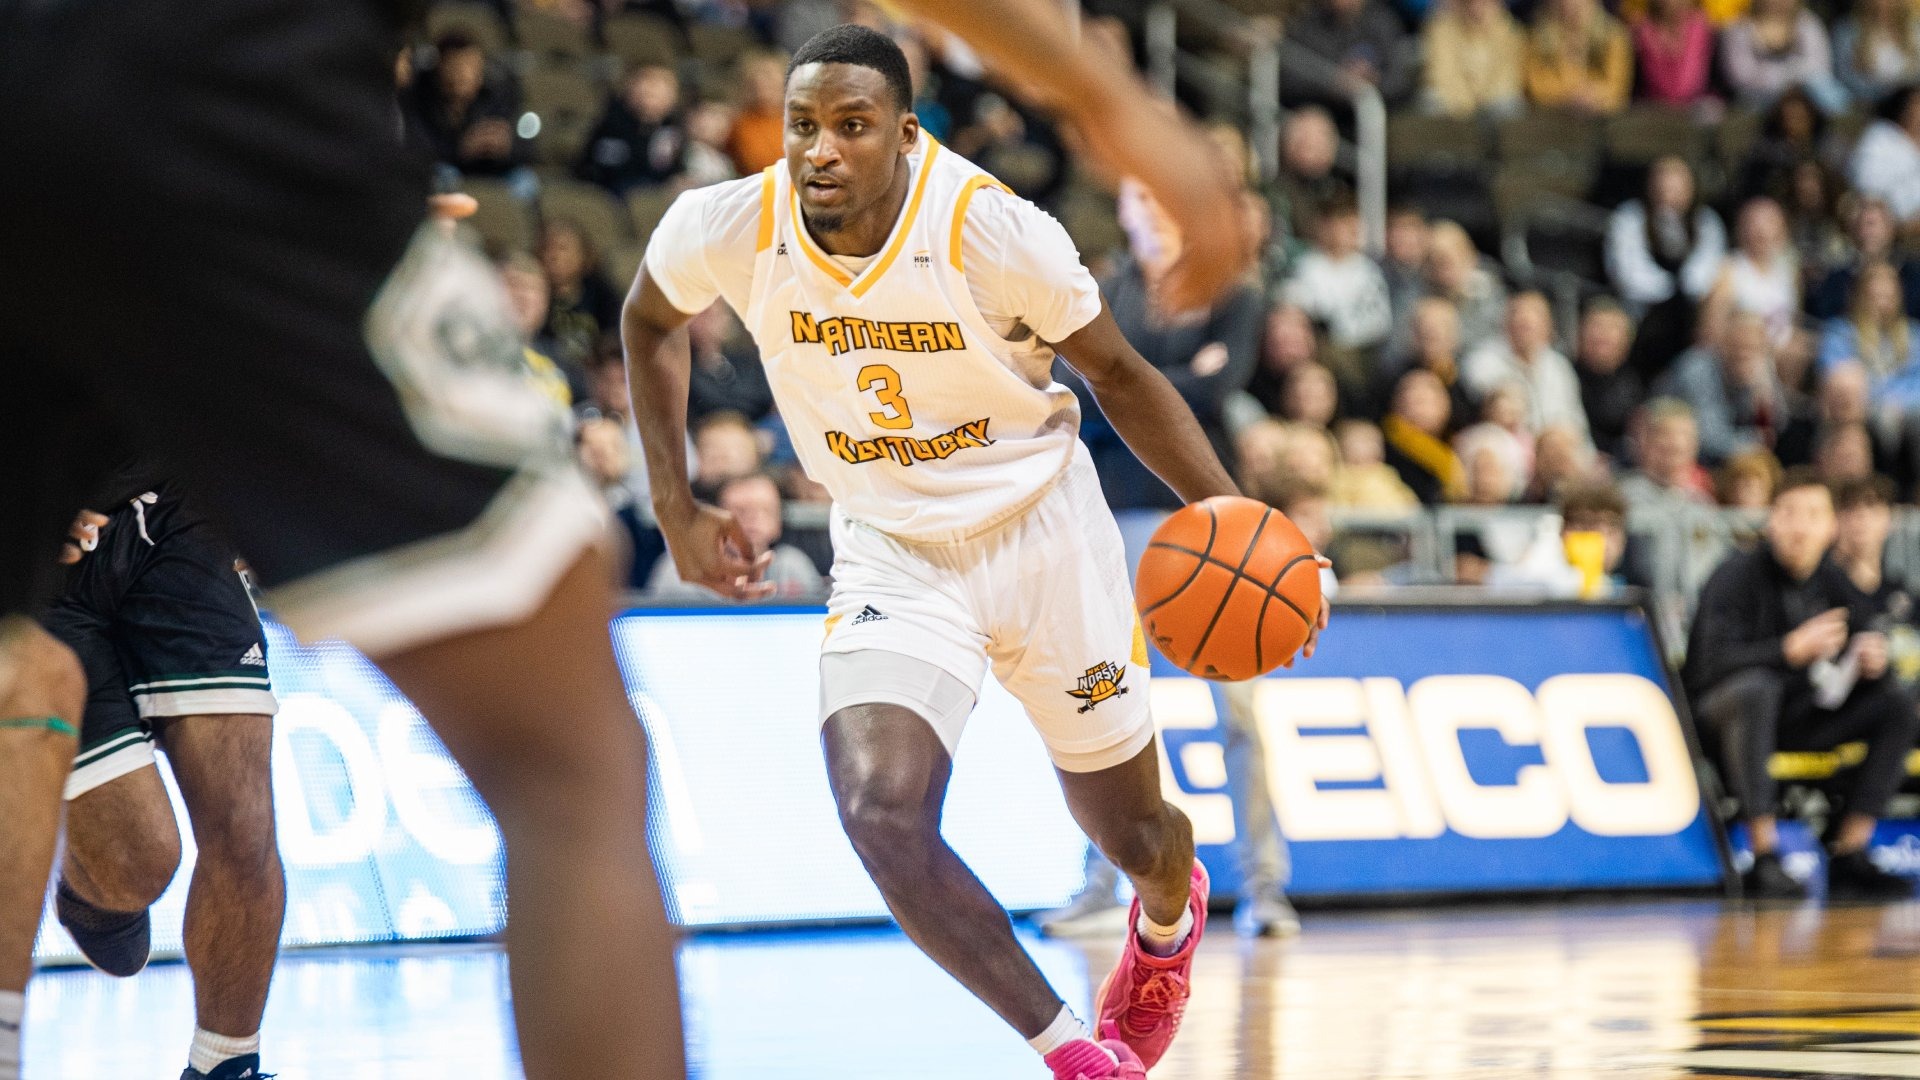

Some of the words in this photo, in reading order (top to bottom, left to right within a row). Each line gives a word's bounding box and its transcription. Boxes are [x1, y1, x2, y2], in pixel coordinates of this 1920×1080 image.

[790, 311, 967, 356] NRTHERN
[857, 364, 914, 430] 3
[851, 614, 889, 626] adidas
[1086, 661, 1108, 676] NKU
[1150, 673, 1700, 845] GEICO
